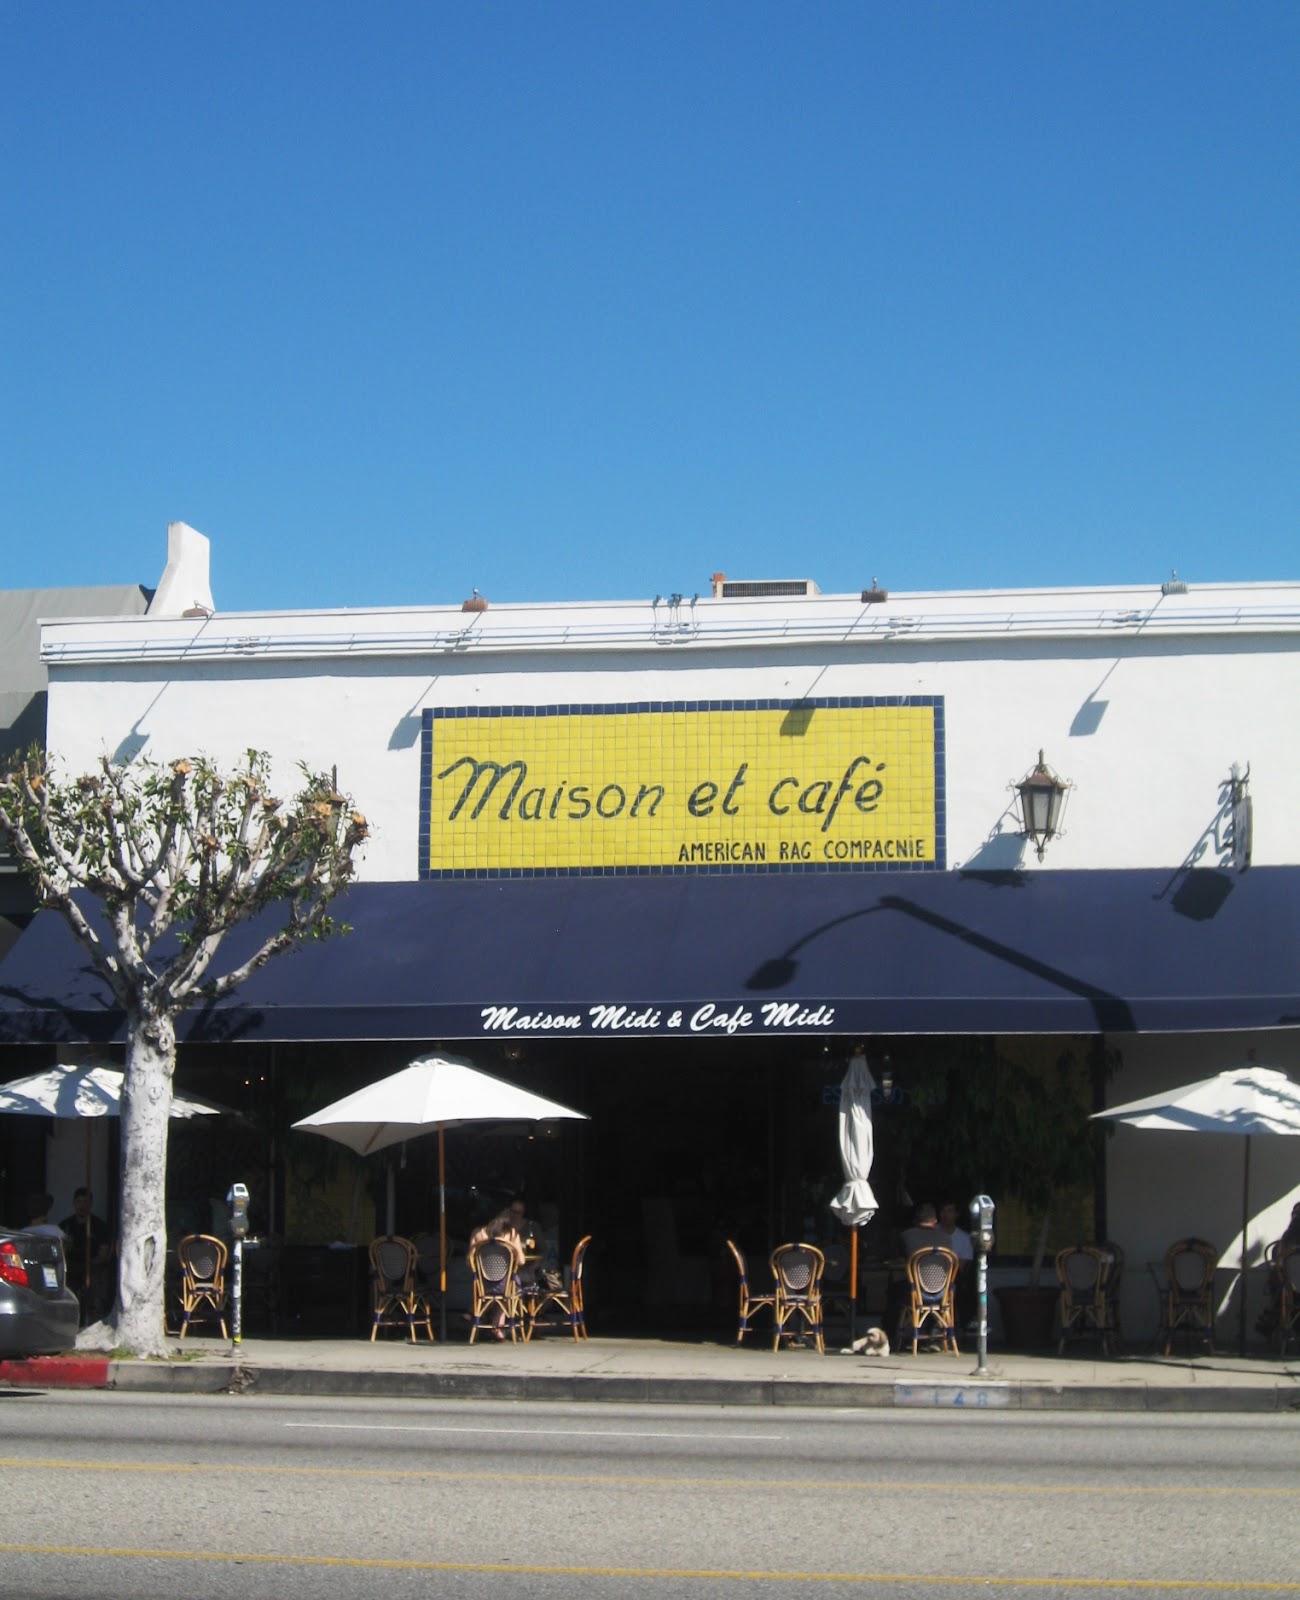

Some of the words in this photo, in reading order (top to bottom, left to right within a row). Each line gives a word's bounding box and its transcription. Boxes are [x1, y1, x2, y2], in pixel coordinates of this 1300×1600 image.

[437, 756, 664, 821] Maison
[687, 763, 749, 818] et
[768, 756, 886, 833] café
[779, 841, 812, 860] RAG
[480, 1006, 581, 1031] Maison
[589, 1004, 661, 1030] Midi
[667, 1009, 682, 1028] &
[690, 1003, 753, 1034] Cafe
[761, 1002, 835, 1027] Midi
